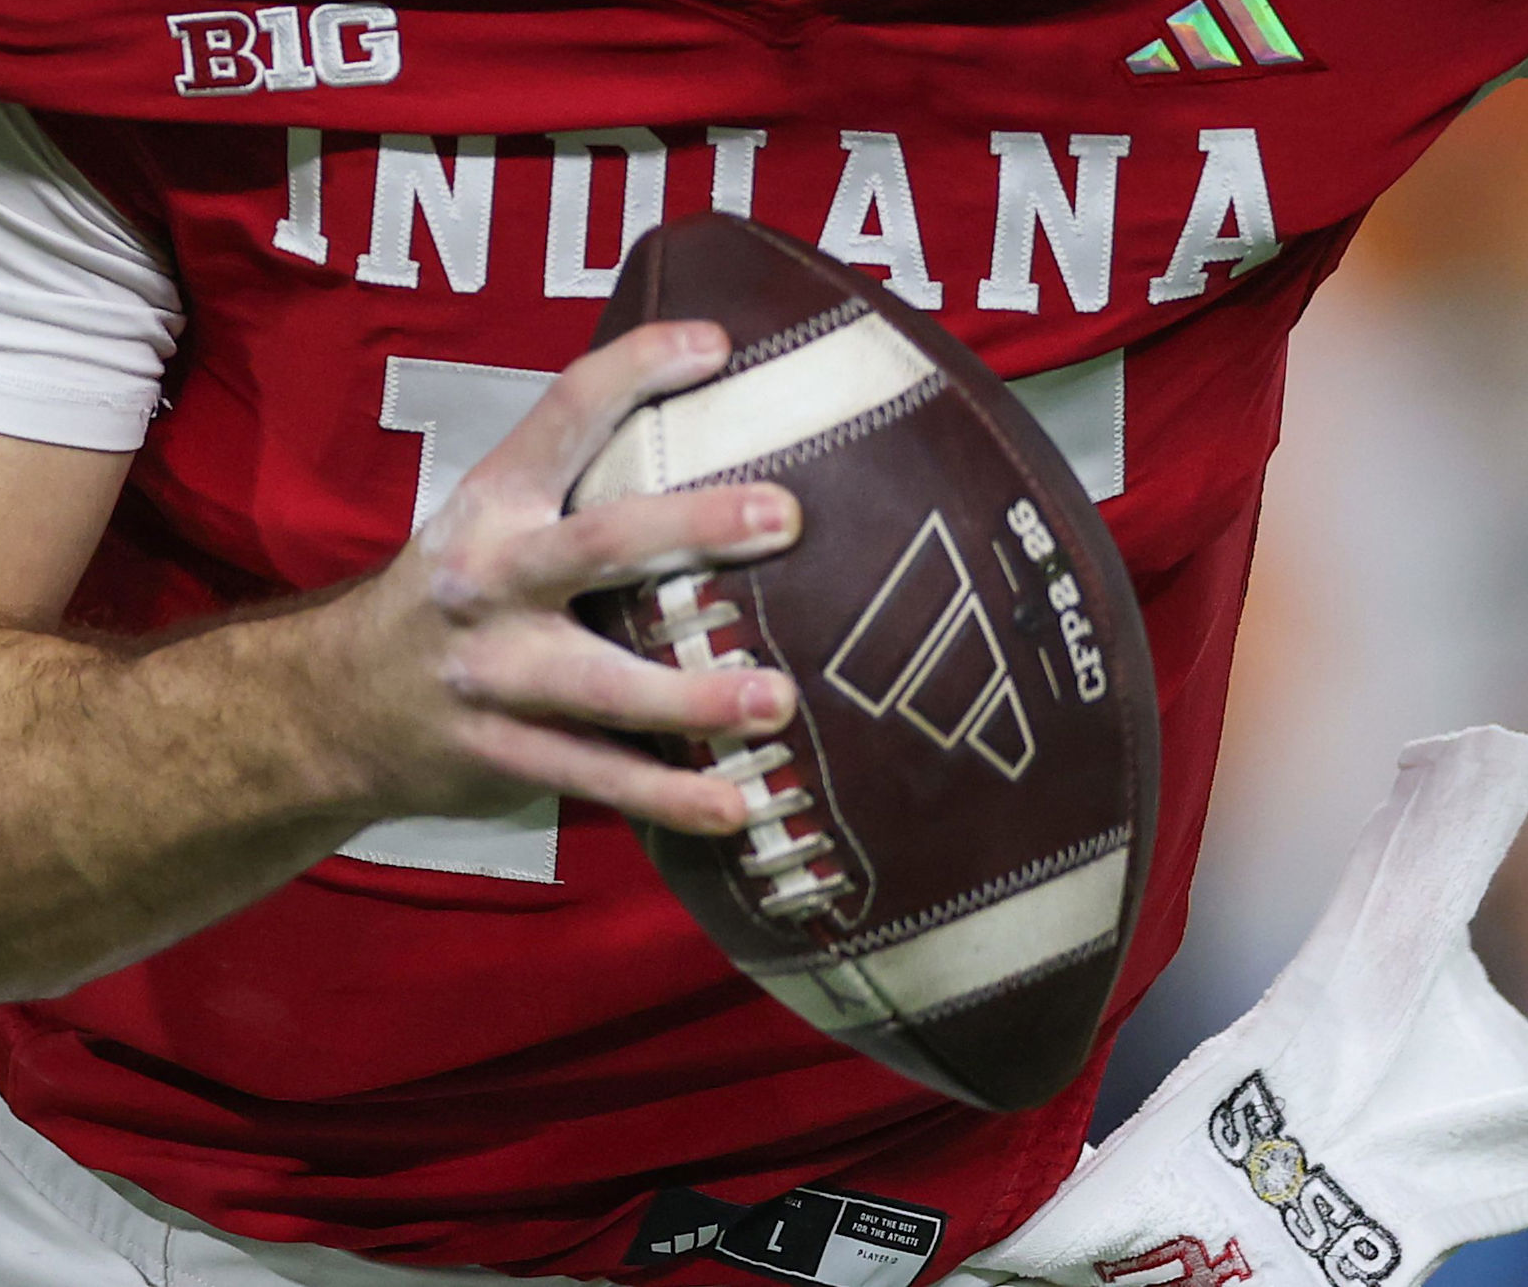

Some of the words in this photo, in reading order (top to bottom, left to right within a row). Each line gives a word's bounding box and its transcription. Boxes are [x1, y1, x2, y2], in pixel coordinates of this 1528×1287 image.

[272, 125, 1285, 313] INDIANA
[852, 1222, 868, 1234] FOR
[870, 1227, 886, 1239] THE
[859, 1212, 879, 1224] ONLY
[882, 1217, 898, 1229] THE
[898, 1222, 918, 1234] BEST
[766, 1219, 785, 1253] L
[857, 1249, 890, 1263] PLAYER
